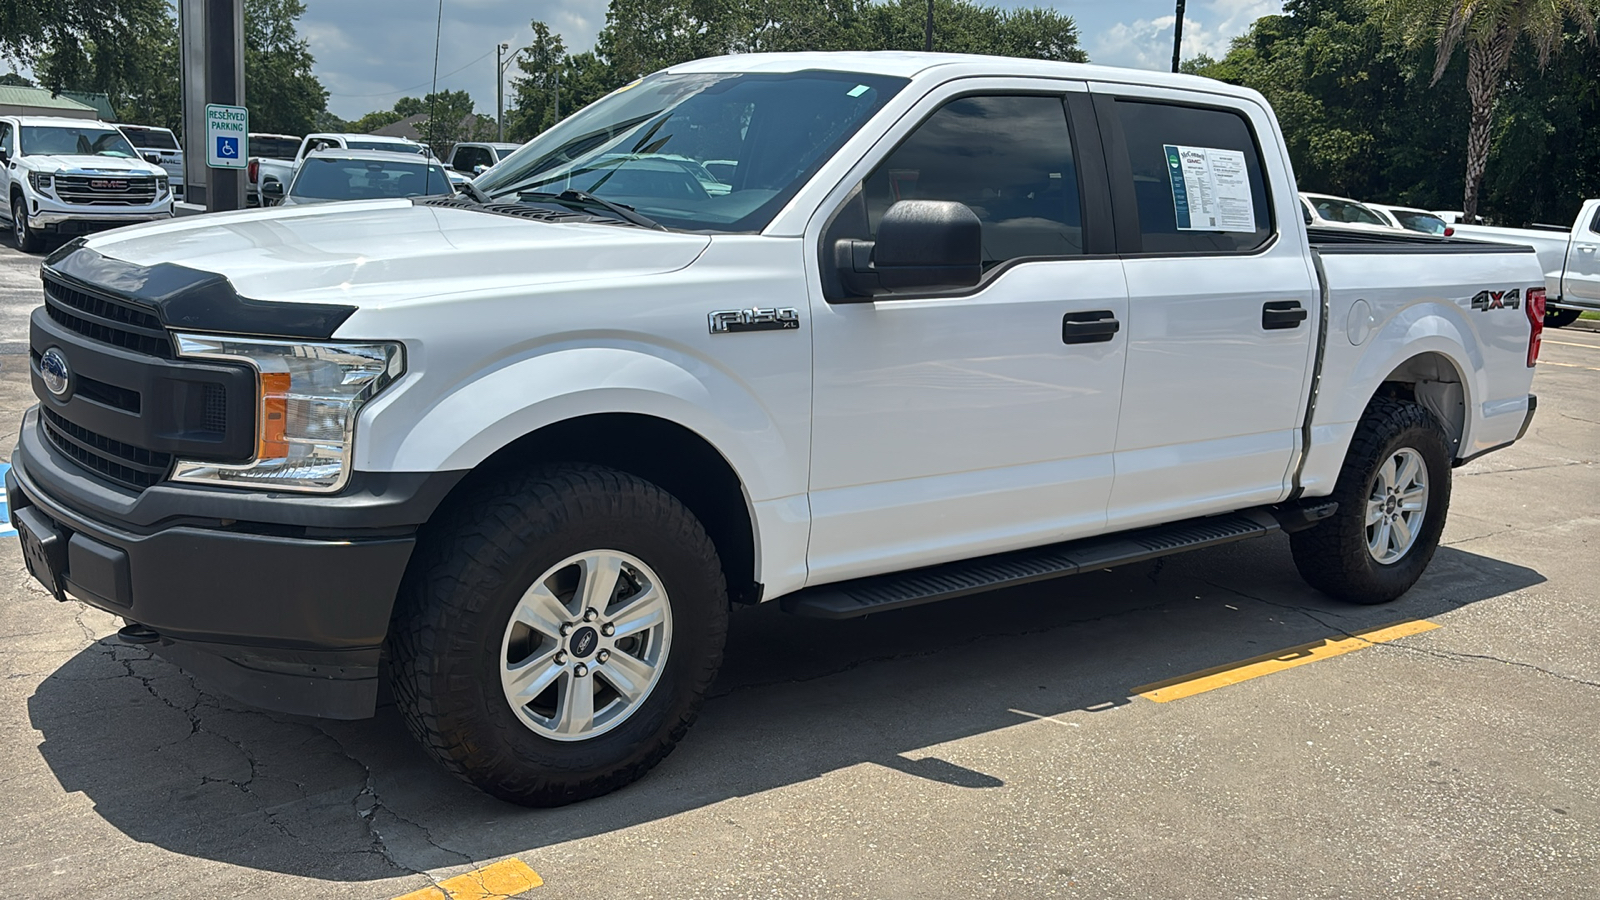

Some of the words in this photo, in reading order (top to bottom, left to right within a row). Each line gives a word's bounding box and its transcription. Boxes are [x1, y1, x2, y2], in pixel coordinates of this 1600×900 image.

[209, 110, 245, 122] RESERVED
[211, 121, 243, 132] PARKING
[91, 180, 127, 188] GMC
[707, 306, 799, 334] F150
